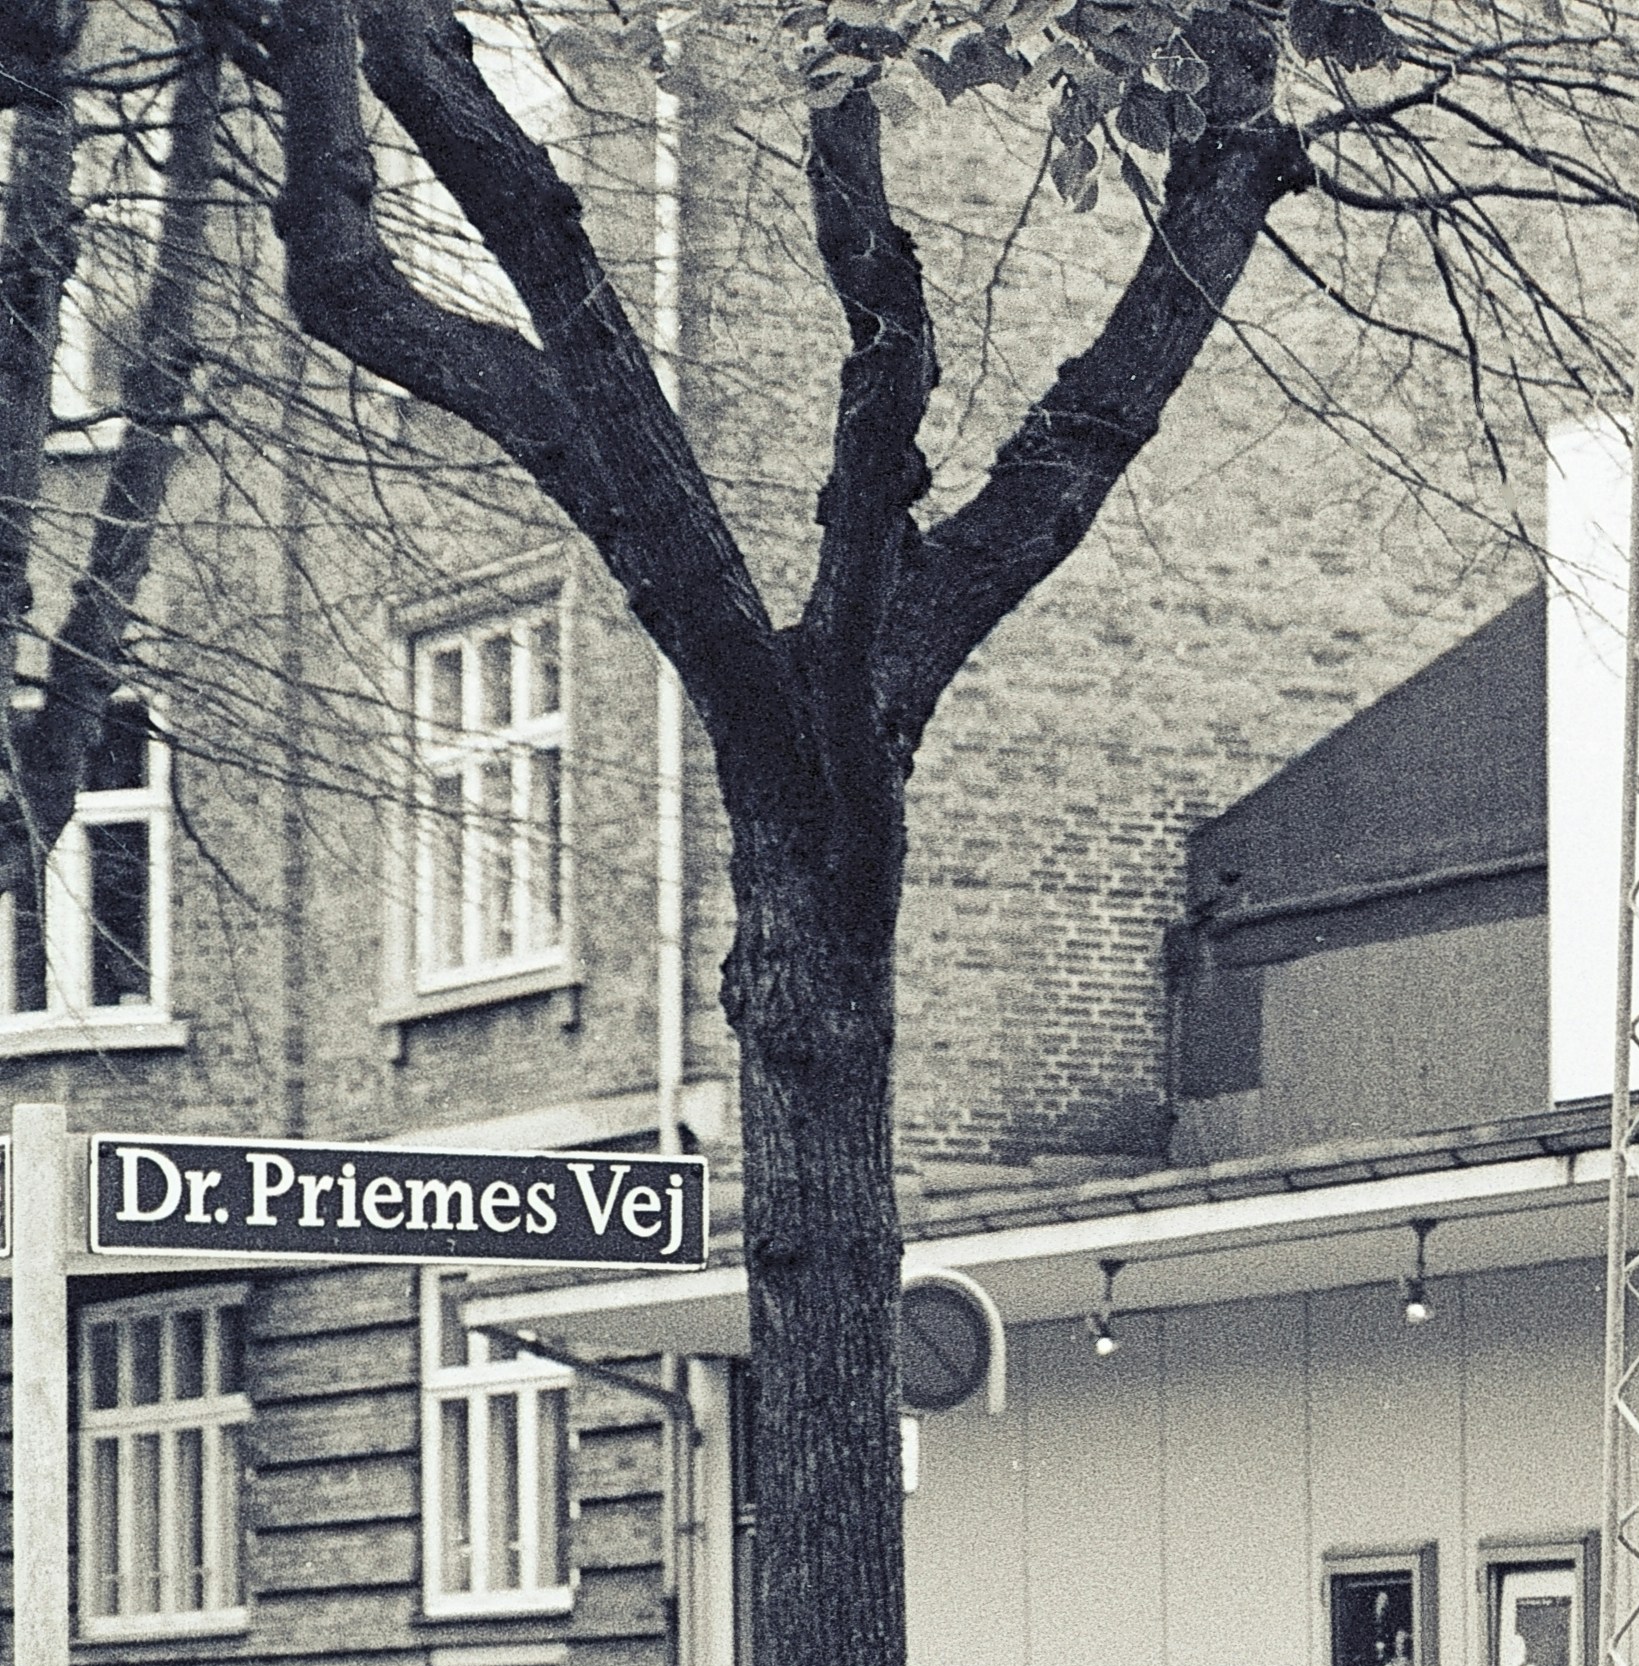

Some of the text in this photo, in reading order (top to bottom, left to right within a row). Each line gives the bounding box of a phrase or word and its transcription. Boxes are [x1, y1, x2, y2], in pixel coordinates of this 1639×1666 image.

[115, 1147, 685, 1256] Dr. Priemes Vej
